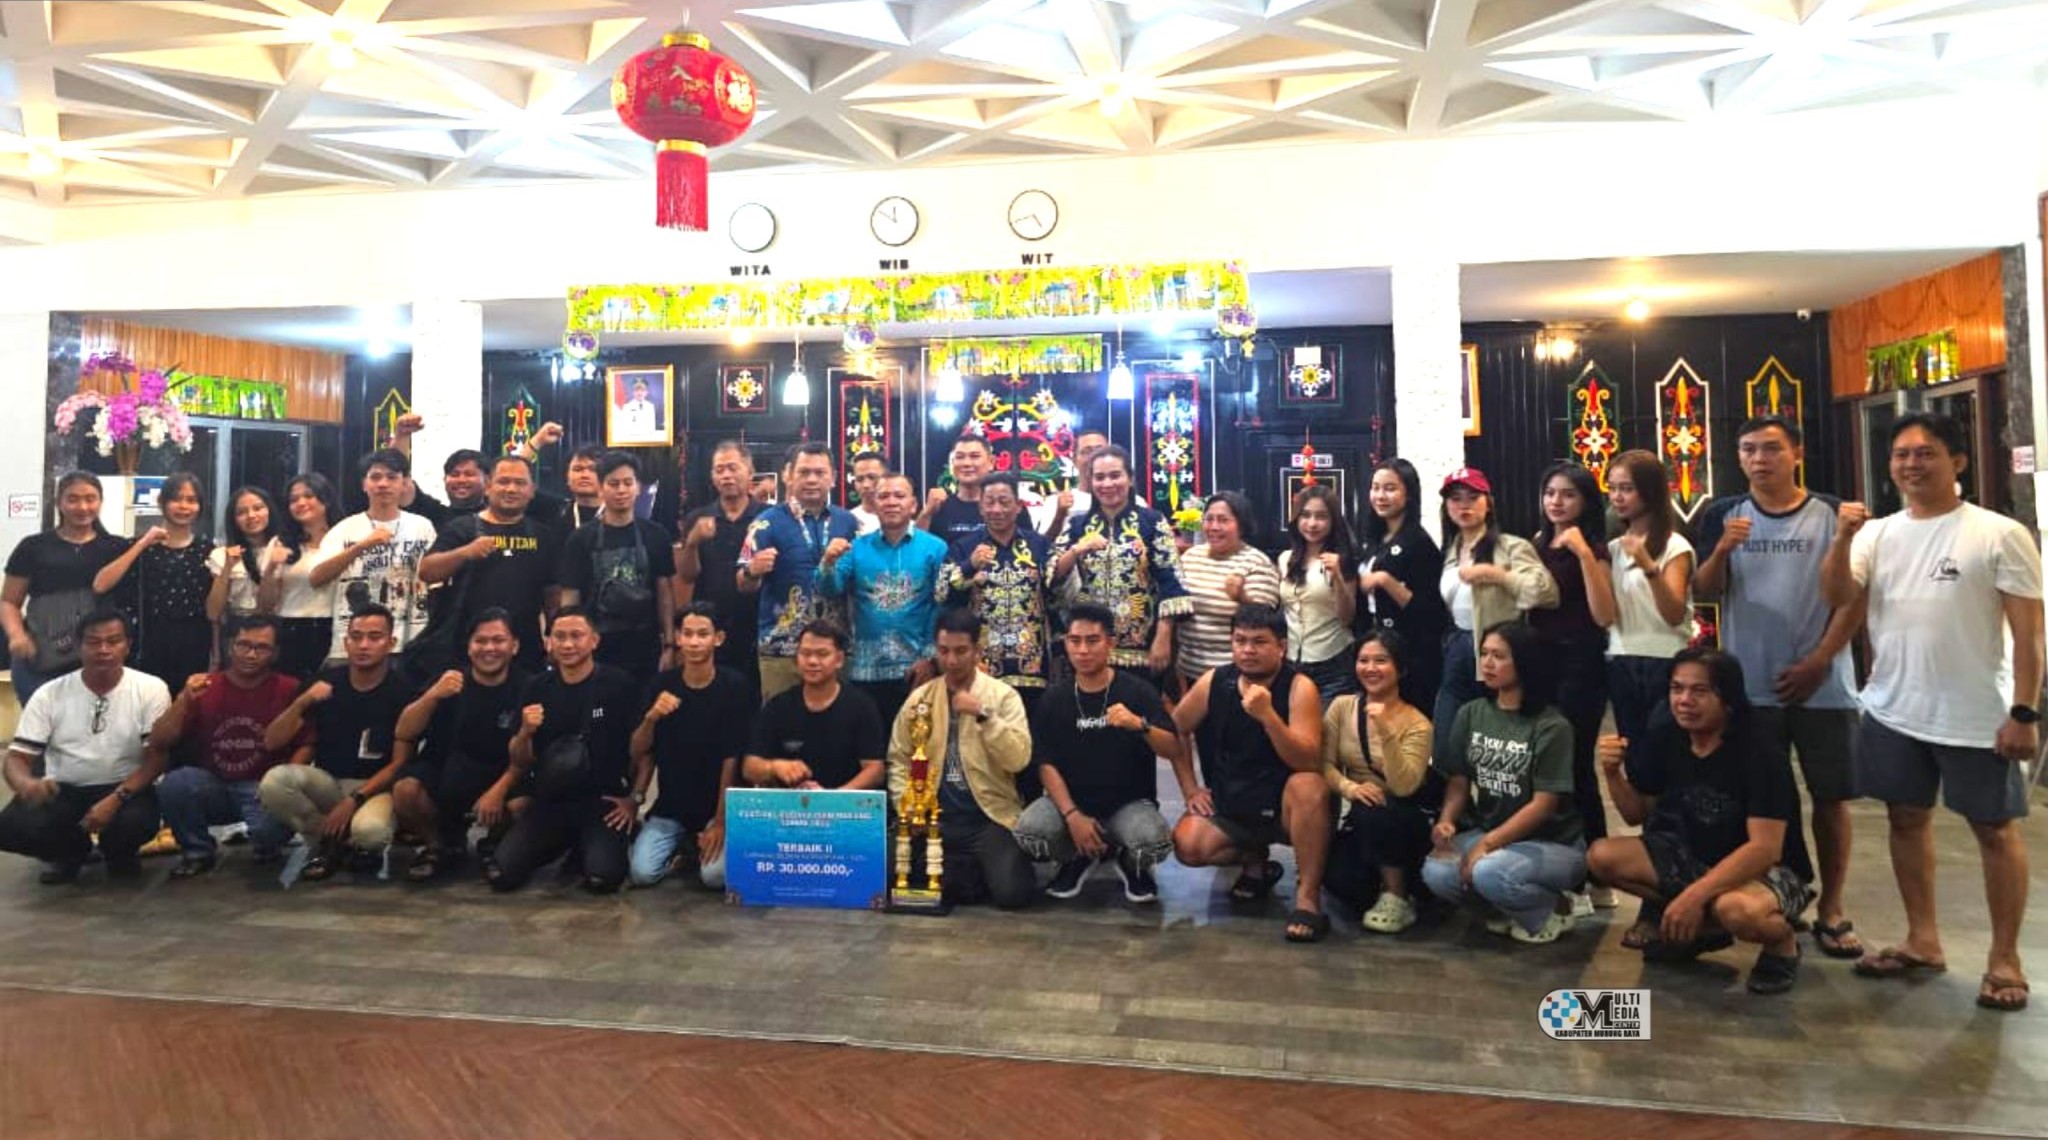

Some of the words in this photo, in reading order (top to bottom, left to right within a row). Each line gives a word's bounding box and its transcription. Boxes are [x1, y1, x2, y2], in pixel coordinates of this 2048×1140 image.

[879, 258, 909, 270] WIB
[1021, 252, 1053, 264] WIT
[730, 264, 771, 276] WITA
[776, 842, 822, 853] TERBAIK
